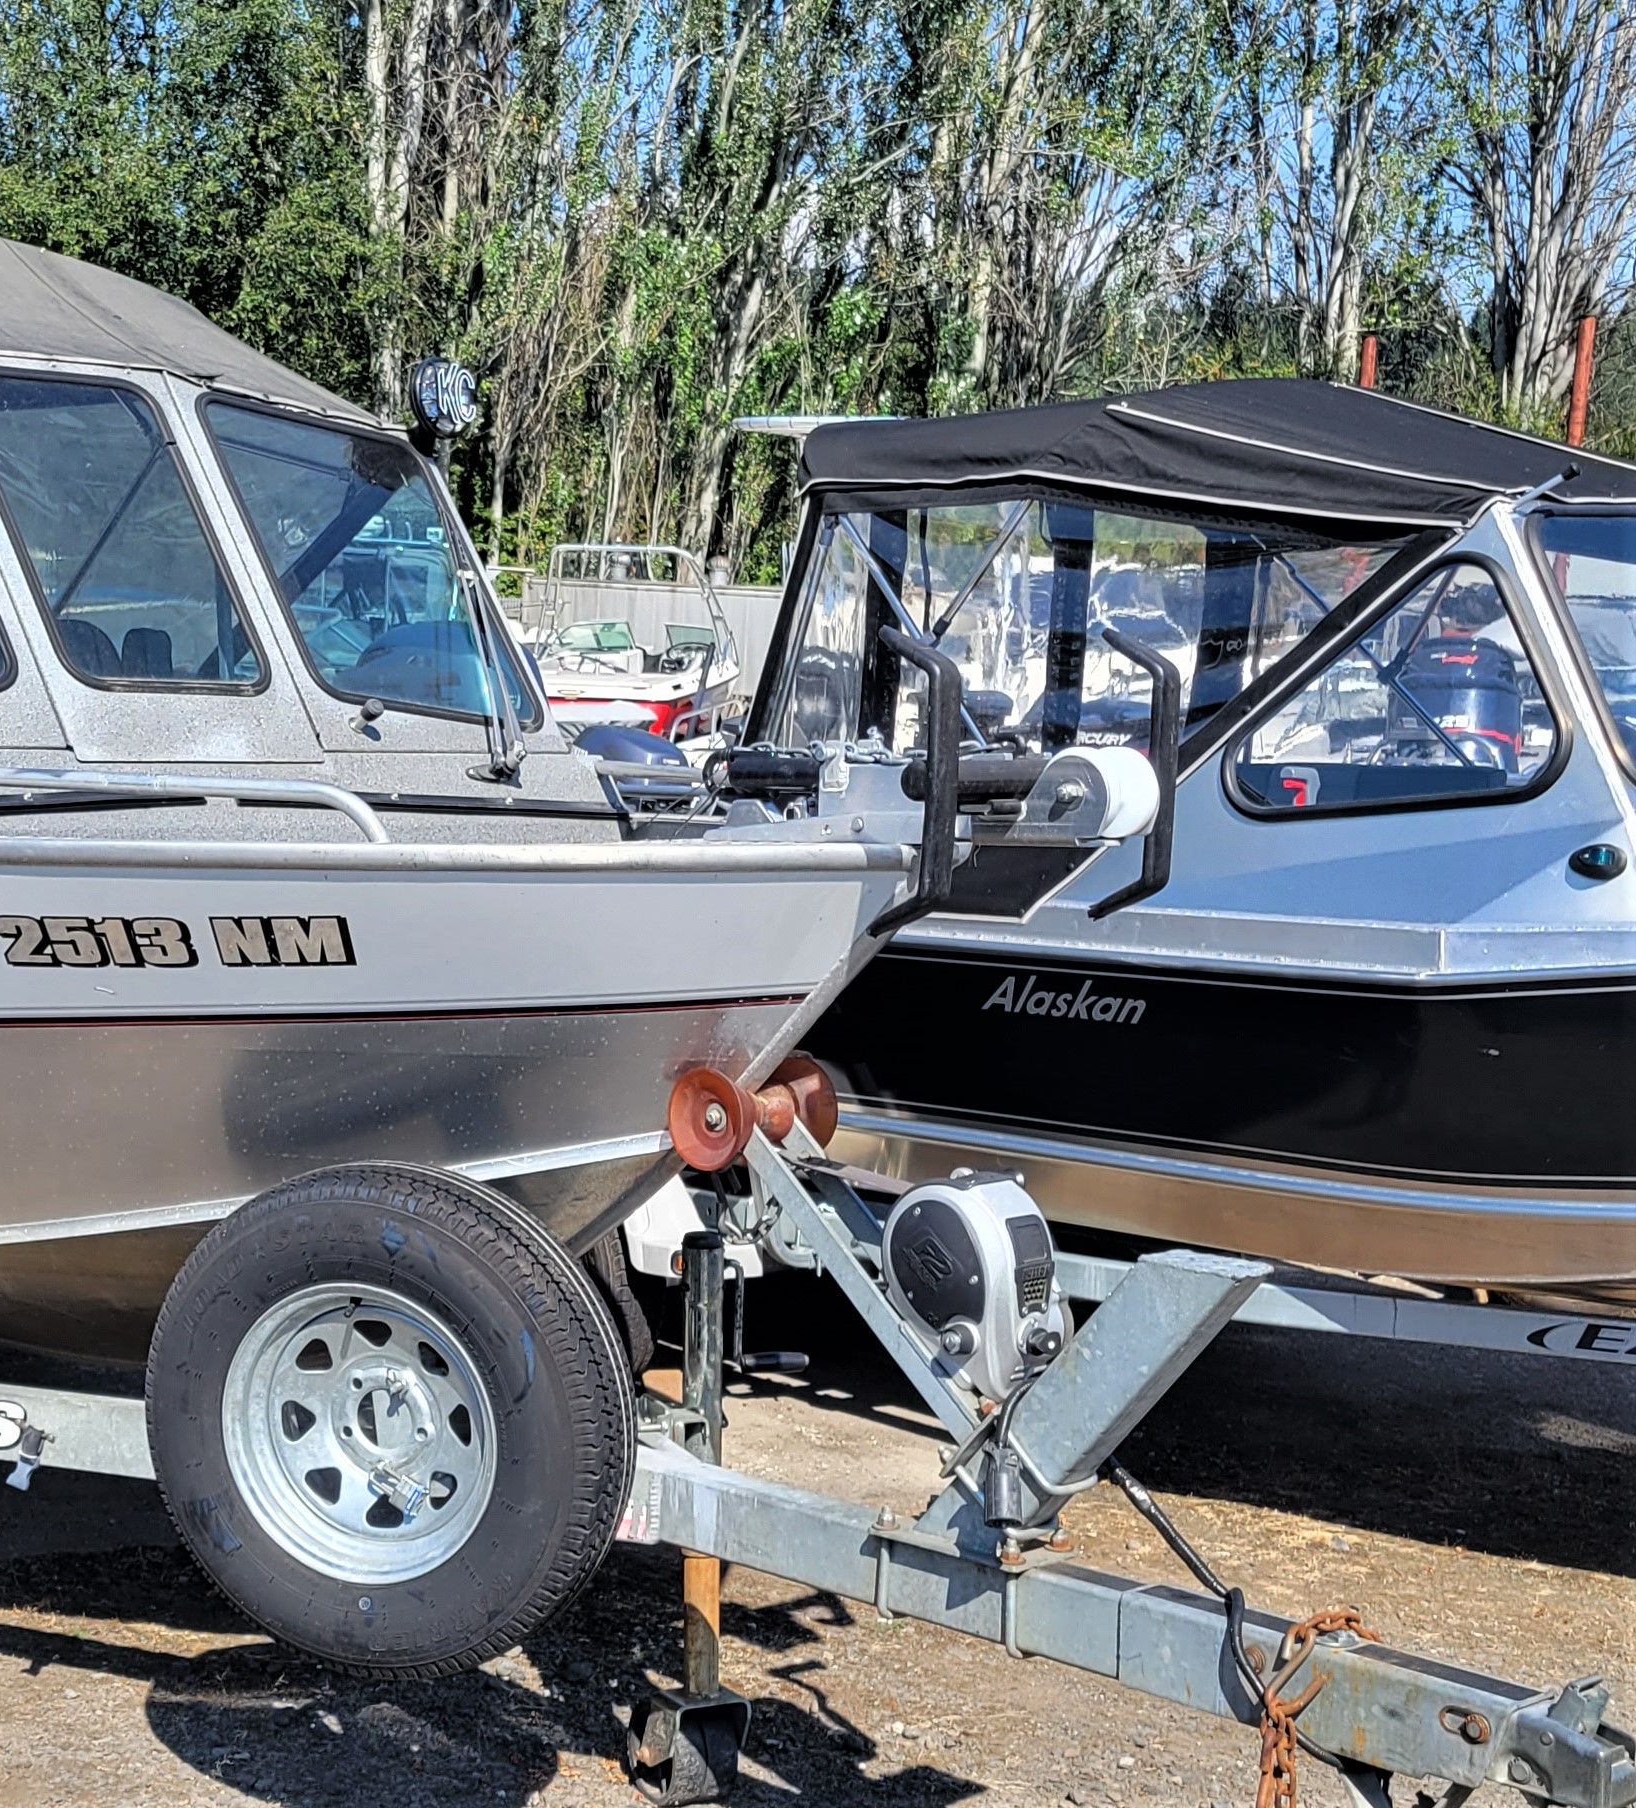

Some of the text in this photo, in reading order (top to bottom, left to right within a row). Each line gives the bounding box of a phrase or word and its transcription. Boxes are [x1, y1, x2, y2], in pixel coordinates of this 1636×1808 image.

[437, 363, 477, 424] KC
[207, 914, 358, 968] NM
[981, 974, 1147, 1025] Alaskan
[1575, 1323, 1636, 1355] E
